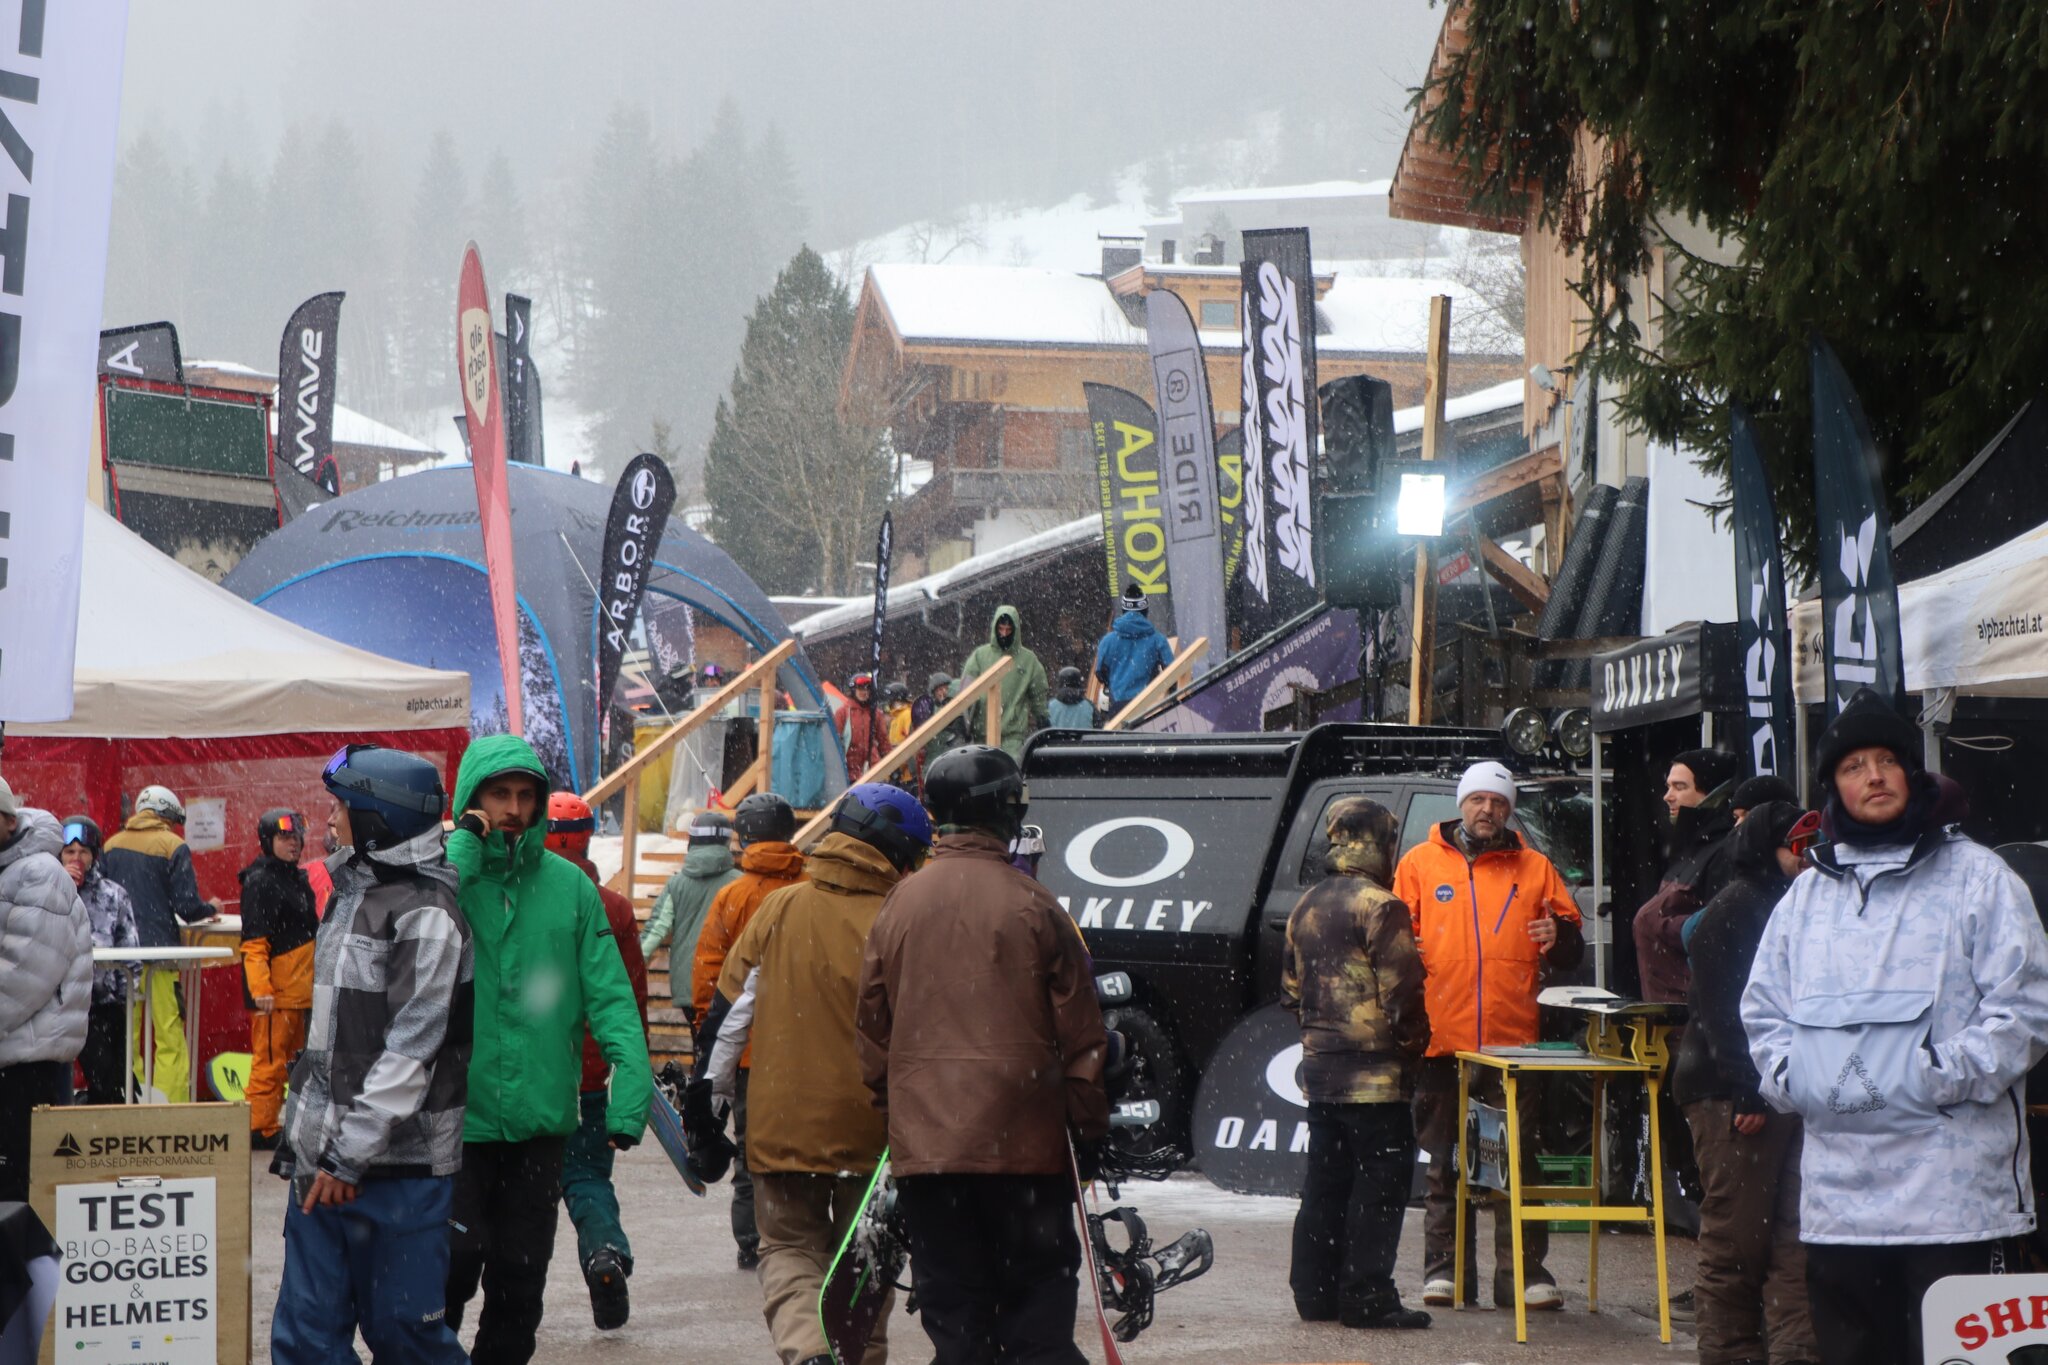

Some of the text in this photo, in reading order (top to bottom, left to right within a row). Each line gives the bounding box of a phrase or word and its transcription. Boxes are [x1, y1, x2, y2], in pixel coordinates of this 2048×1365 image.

[321, 508, 516, 533] Reichma
[629, 516, 651, 609] SNOWBOARDS
[608, 513, 644, 652] ARBOR
[1978, 613, 2042, 645] alpbachtal.at
[1603, 644, 1684, 712] OAKLEY
[406, 696, 462, 714] alpbachtal.at
[1057, 896, 1210, 933] KLEY
[89, 1133, 229, 1156] SPEKTRUM
[1214, 1116, 1312, 1153] OAK
[66, 1155, 214, 1169] BIO-BASED PERFORMANCE
[79, 1191, 194, 1232] TEST
[66, 1233, 208, 1259] BIO-BASED
[66, 1255, 208, 1284] GOGGLES
[130, 1283, 144, 1299] &
[66, 1298, 208, 1329] HELMETS
